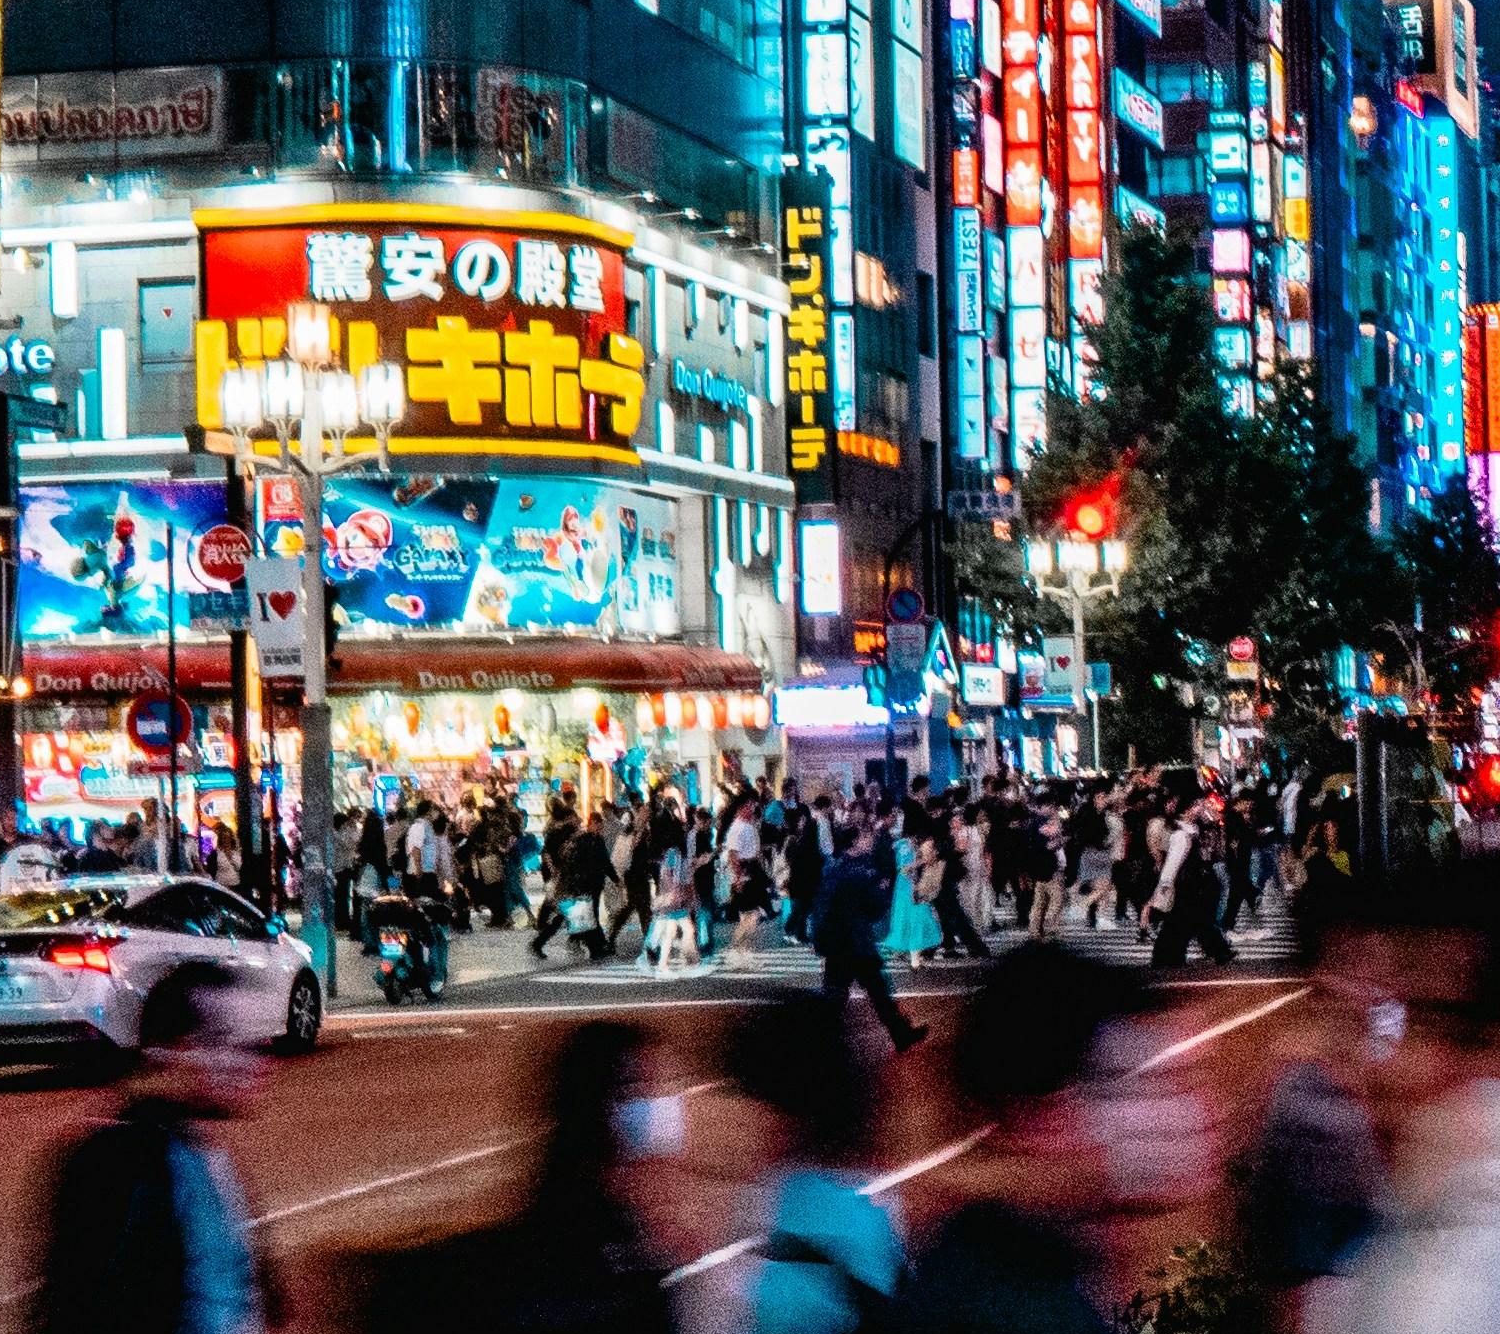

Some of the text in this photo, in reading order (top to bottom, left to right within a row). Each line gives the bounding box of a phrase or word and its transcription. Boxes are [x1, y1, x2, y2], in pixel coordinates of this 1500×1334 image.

[1071, 35, 1096, 163] PARTY
[307, 232, 604, 312] 驚安の殿堂
[674, 357, 701, 395] Don
[36, 672, 82, 693] Don
[419, 670, 465, 690] Don
